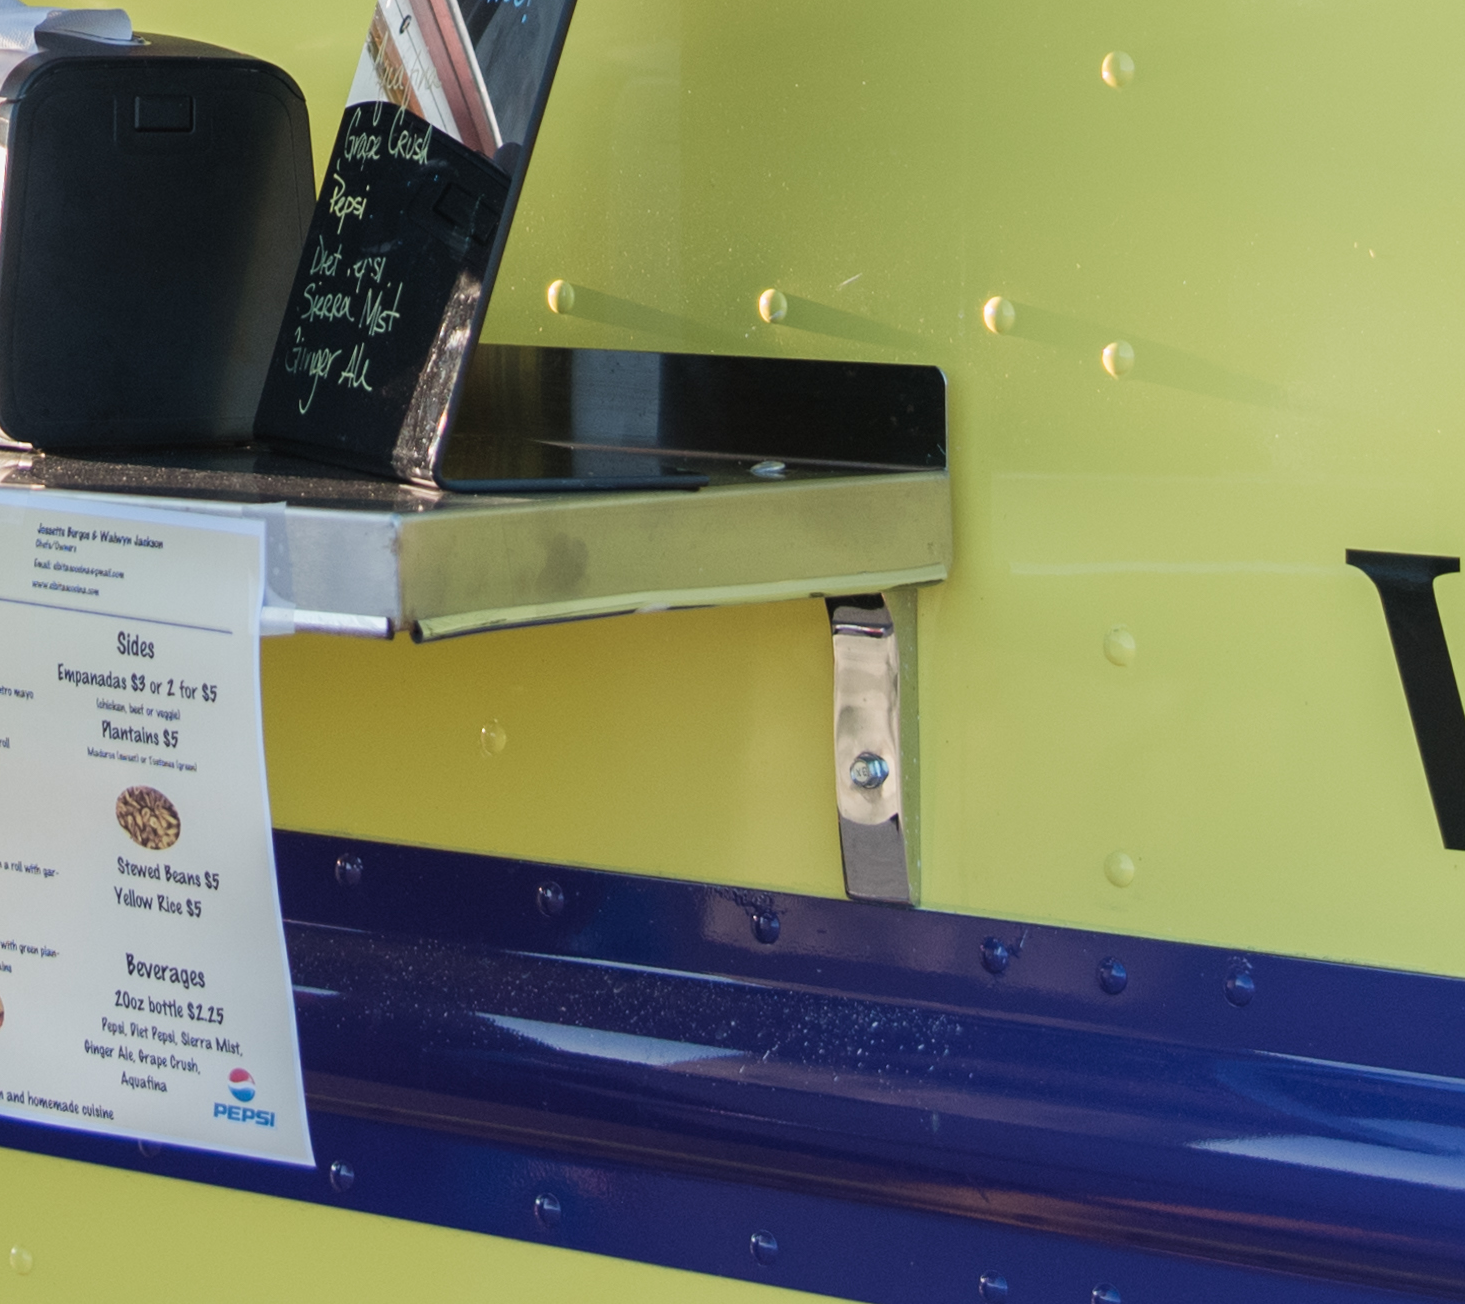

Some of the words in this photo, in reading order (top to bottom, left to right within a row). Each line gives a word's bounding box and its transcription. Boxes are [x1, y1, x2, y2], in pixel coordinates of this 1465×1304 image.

[329, 173, 370, 234] Pepsi
[310, 235, 342, 276] Diet
[301, 283, 355, 321] Sierra
[359, 282, 403, 336] Mist
[338, 342, 373, 391] Ale
[117, 630, 155, 659] Sides
[57, 663, 127, 691] Empanadas
[131, 672, 146, 692] $3
[149, 680, 162, 695] or
[167, 678, 175, 697] 2
[179, 680, 198, 700] for
[202, 682, 218, 703] $5
[102, 719, 160, 746] Plantains
[163, 728, 179, 748] $5
[117, 856, 161, 880] Stewed
[164, 864, 201, 888] Beans
[204, 870, 220, 891] $5
[113, 886, 153, 910] Yellow
[157, 894, 183, 915] Rice
[186, 898, 202, 918] $5
[125, 952, 205, 989] Beverages
[114, 990, 145, 1012] 20oz
[148, 995, 184, 1018] bottle
[187, 1001, 224, 1025] $2.25
[101, 1016, 127, 1037] Pepsi,
[130, 1022, 148, 1040] Diet
[151, 1025, 178, 1046] Pepsi,
[181, 1031, 213, 1050] Sierra
[215, 1037, 243, 1057] Mist,
[84, 1039, 114, 1059] Ginger
[118, 1045, 136, 1063] Ale,
[138, 1049, 167, 1069] Grape
[170, 1054, 201, 1075] Crush,
[121, 1070, 168, 1093] Aquafina
[6, 1090, 25, 1105] and
[27, 1091, 80, 1114] homemade
[81, 1100, 115, 1120] cuisine
[213, 1102, 276, 1127] PEPSI
